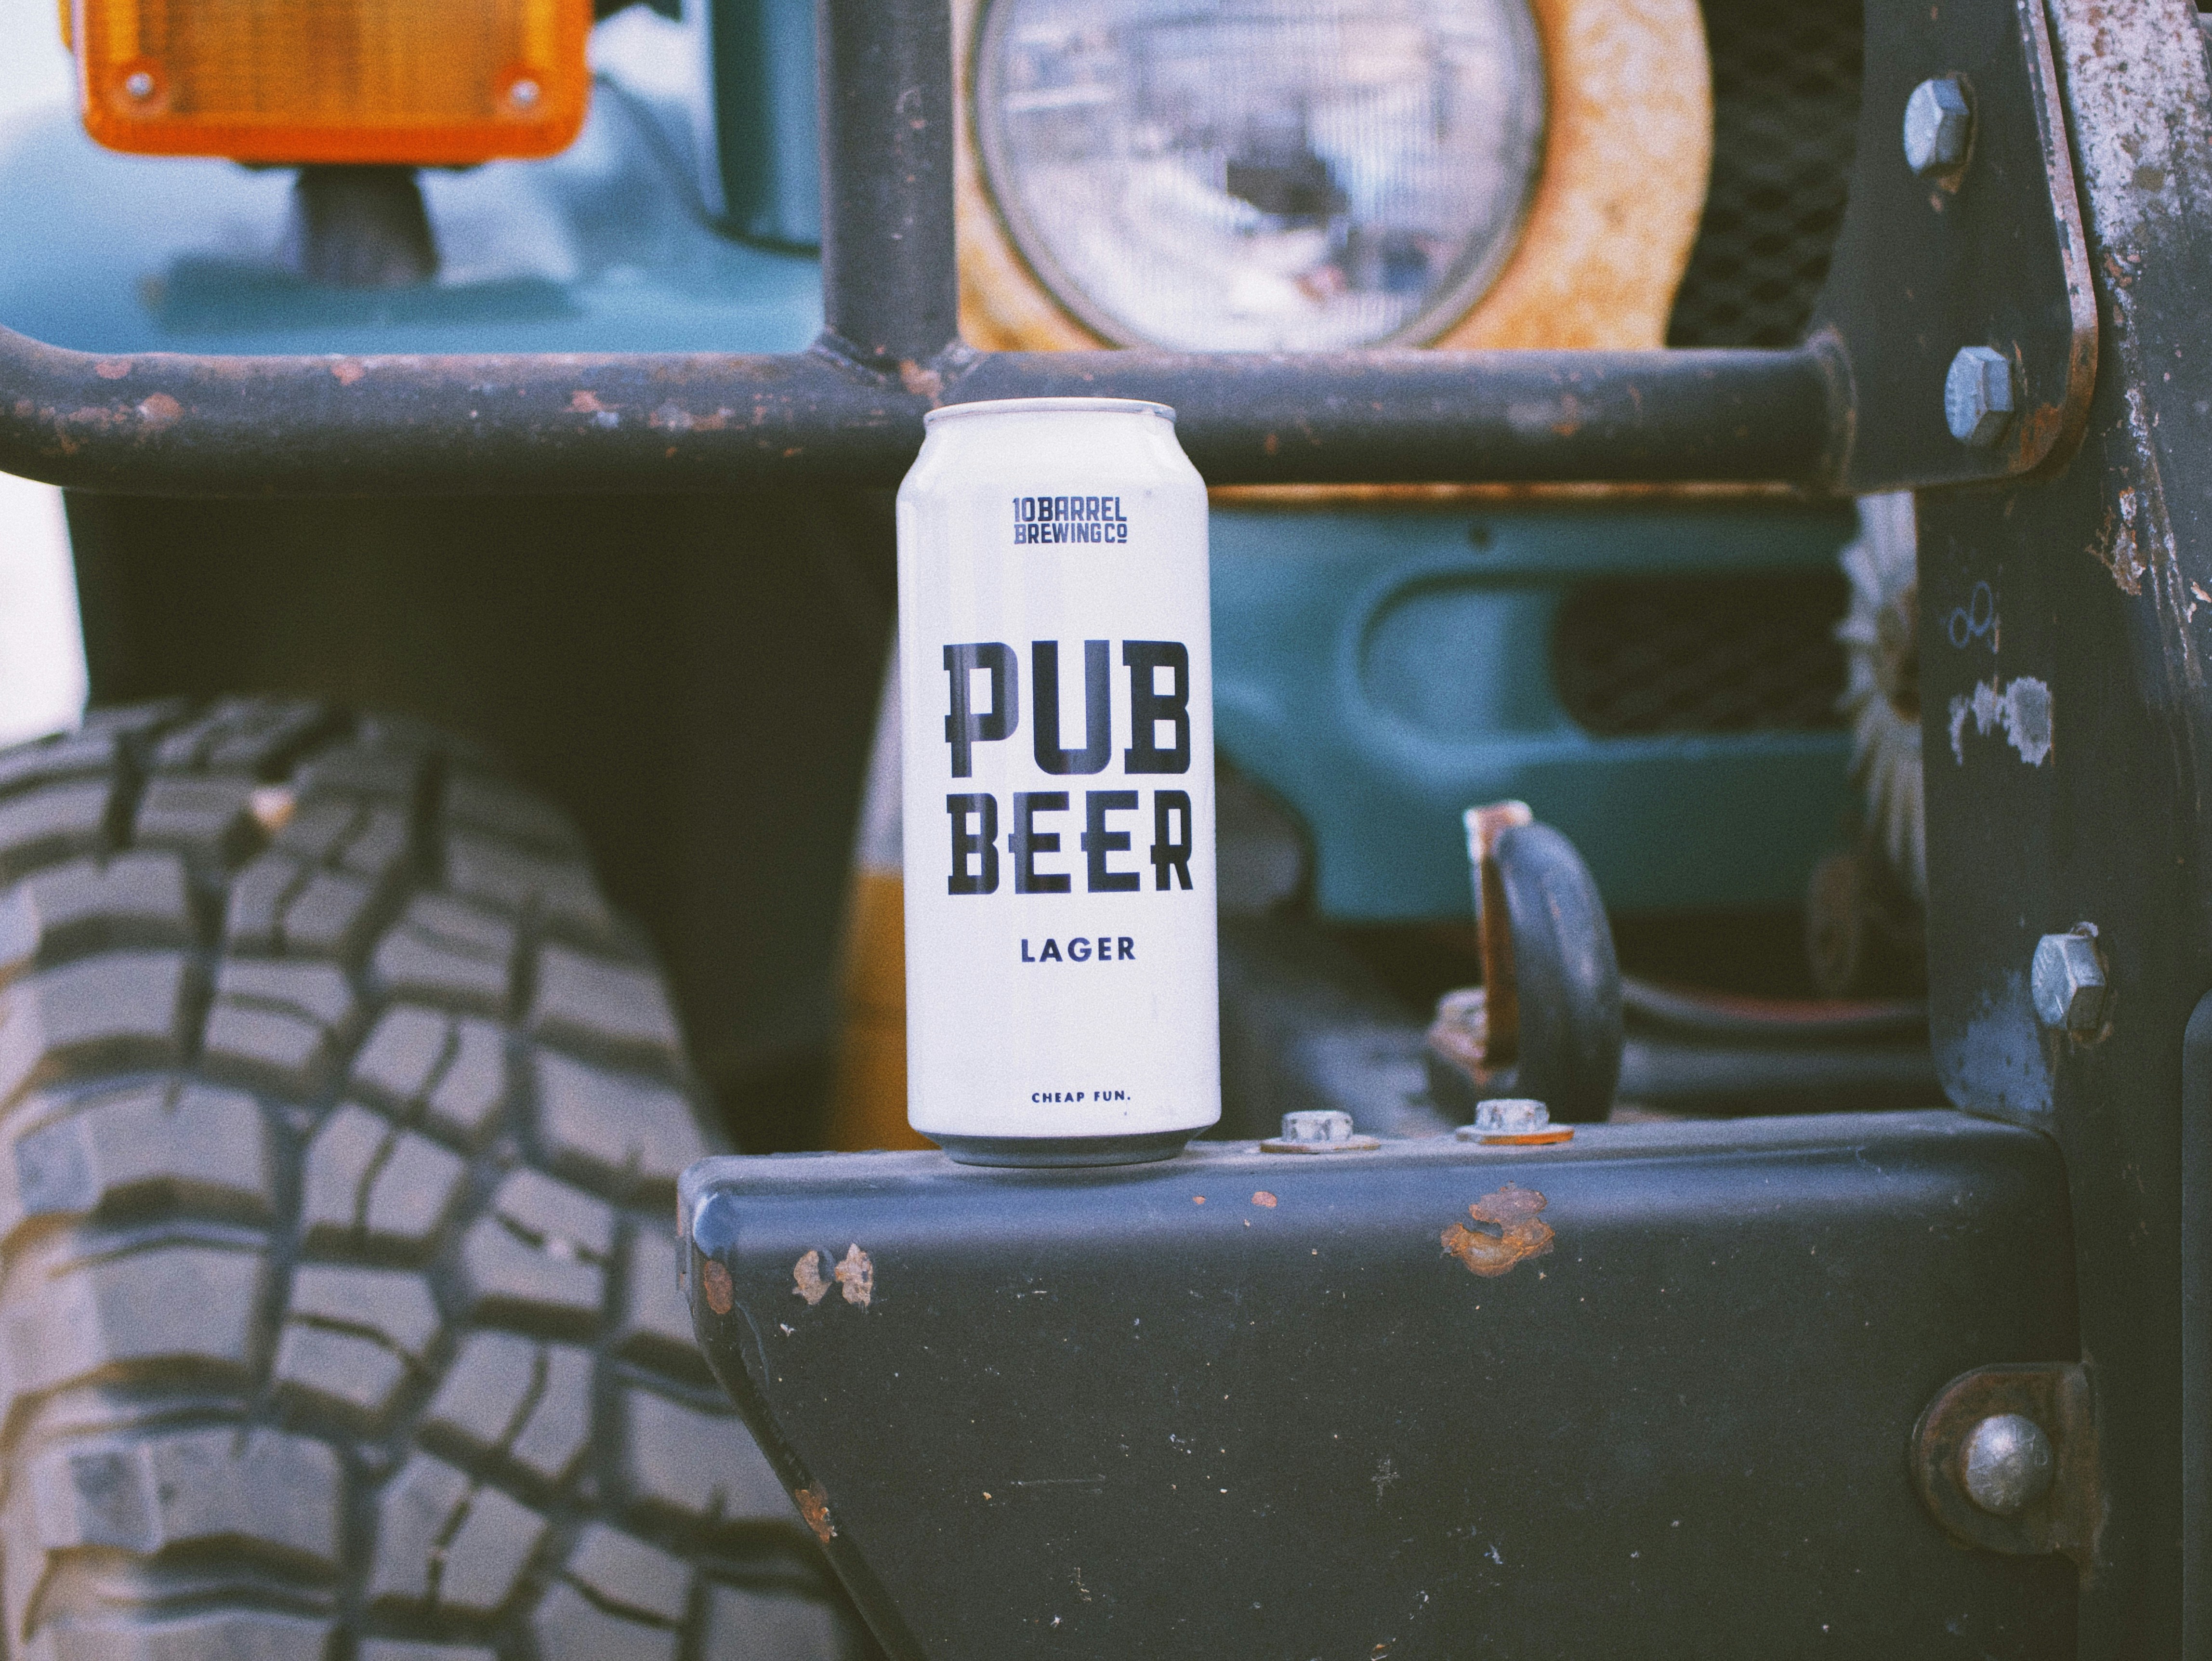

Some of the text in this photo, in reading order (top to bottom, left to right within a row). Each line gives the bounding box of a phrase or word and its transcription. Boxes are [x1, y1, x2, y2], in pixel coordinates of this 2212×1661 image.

[943, 640, 1191, 778] PUB
[947, 790, 1193, 895] BEER
[1021, 936, 1136, 962] LAGER
[1031, 1090, 1131, 1103] CHEAP FUN.
